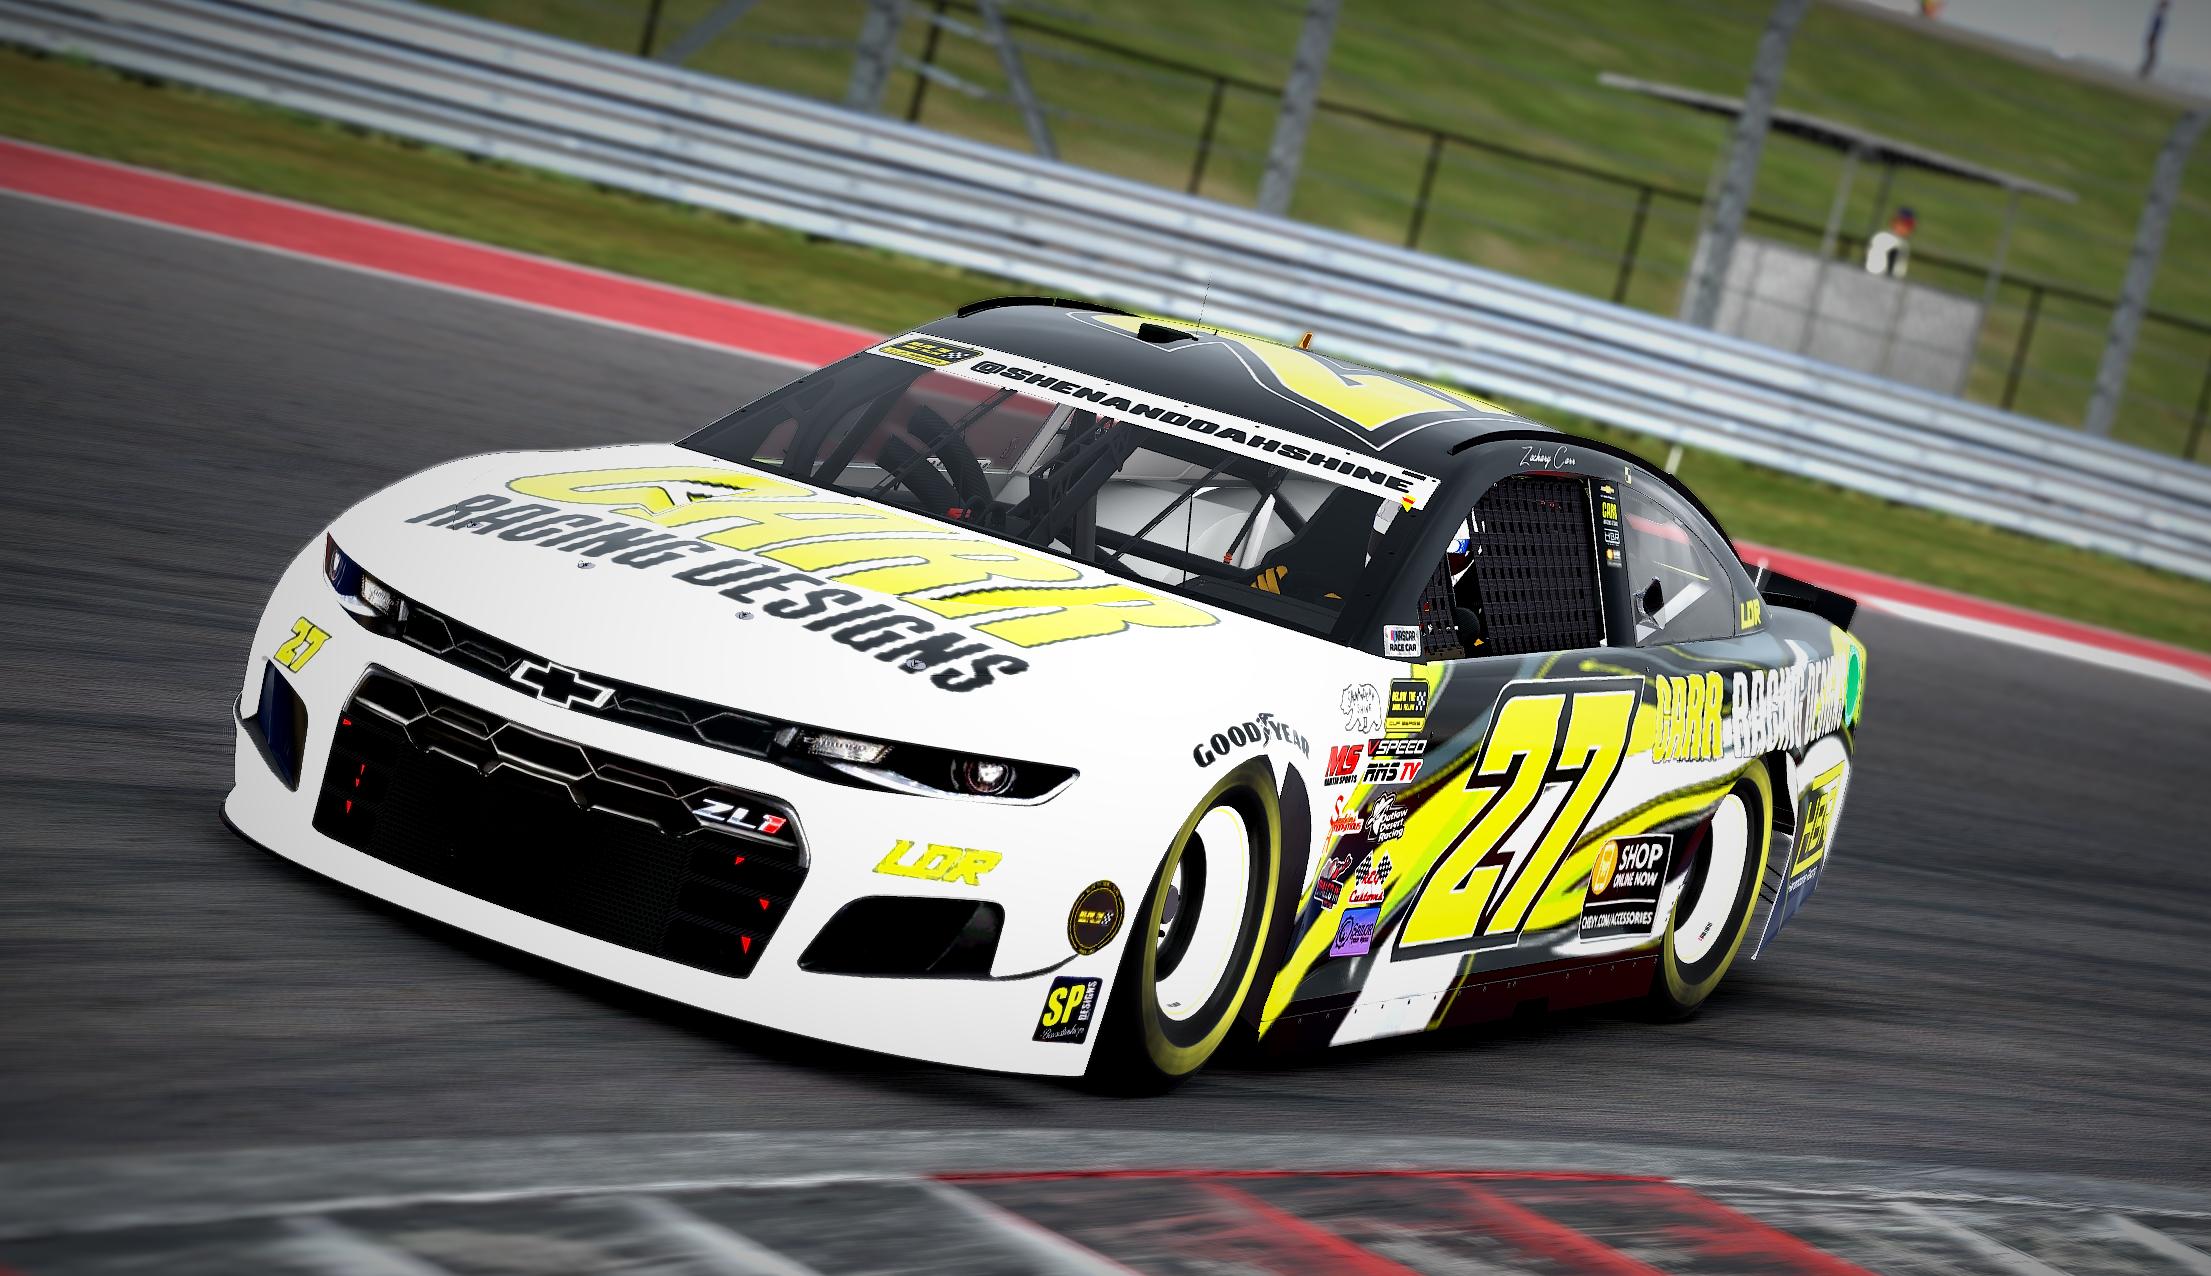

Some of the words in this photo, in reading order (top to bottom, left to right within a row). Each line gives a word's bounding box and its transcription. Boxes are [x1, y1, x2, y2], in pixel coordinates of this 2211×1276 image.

[970, 359, 1416, 494] @SHENANDOAHSHINE
[404, 494, 716, 569] RACING
[671, 558, 1030, 692] DESIGNS
[1740, 599, 1761, 630] LDR
[273, 616, 332, 674] 27
[1390, 644, 1404, 652] RACE
[1405, 644, 1417, 652] CAR
[1652, 671, 1724, 764] CARR
[1325, 744, 1364, 777] MS
[1400, 762, 1422, 781] TV
[1380, 808, 1409, 823] Outlaw
[1396, 688, 1639, 950] 27
[1378, 828, 1404, 842] Racing
[872, 839, 1003, 887] LDR
[1618, 842, 1664, 871] SHOP
[1348, 889, 1384, 903] Customs
[1612, 872, 1636, 889] ONLINE
[1634, 871, 1659, 888] NOW
[1581, 911, 1655, 930] CHEVY.COM/ACCESSORIES
[1042, 984, 1086, 1027] SP
[1077, 981, 1098, 1021] DESIGNS
